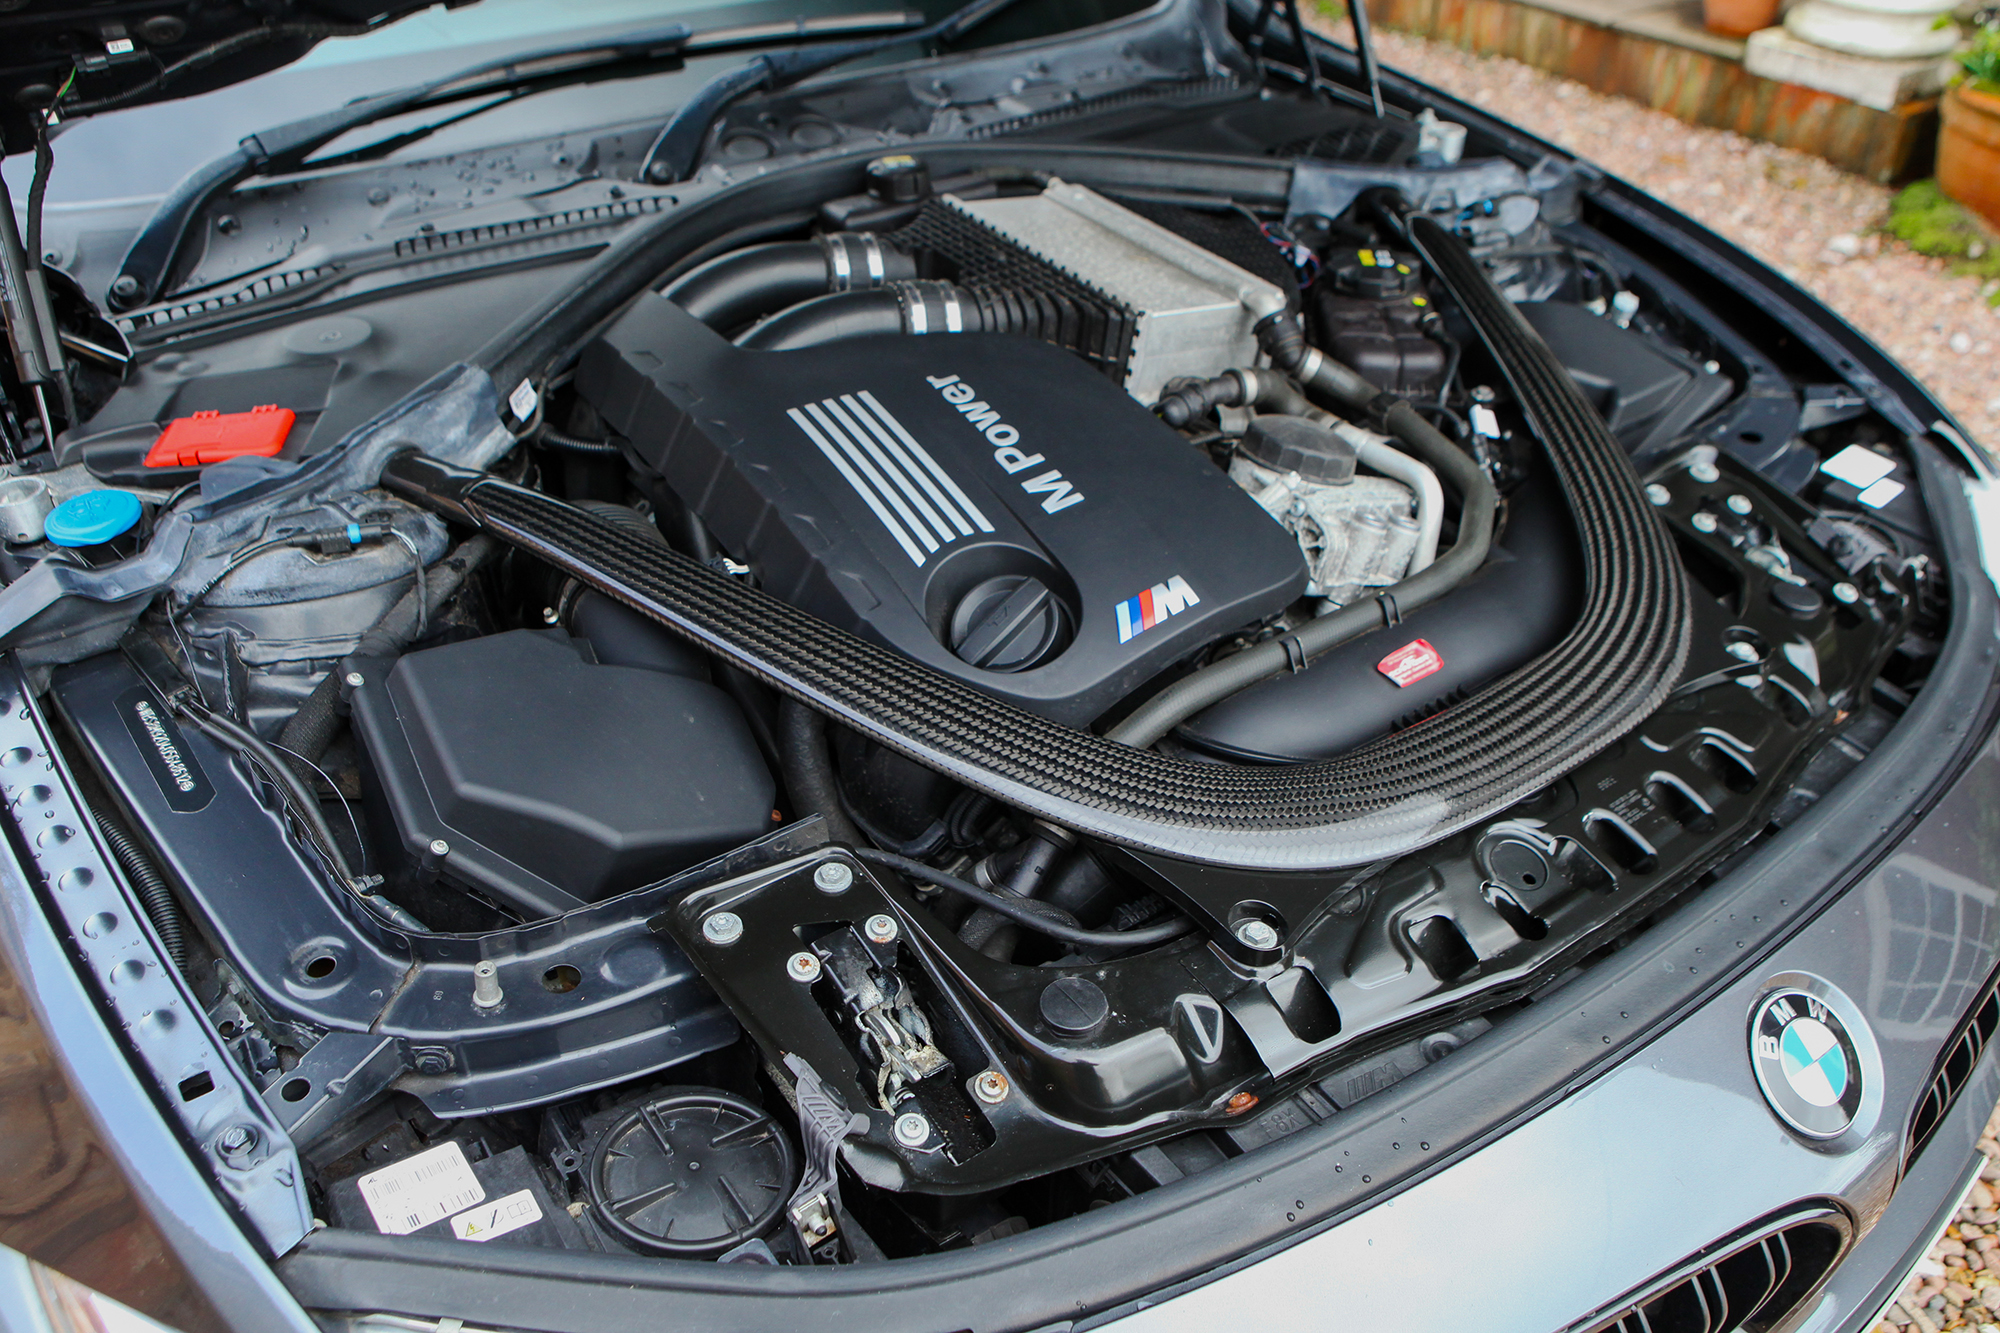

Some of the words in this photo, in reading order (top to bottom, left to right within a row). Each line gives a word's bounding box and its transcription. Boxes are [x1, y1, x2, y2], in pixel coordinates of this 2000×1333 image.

[926, 374, 1046, 475] Power
[1020, 469, 1085, 515] M
[1759, 996, 1829, 1061] BMW
